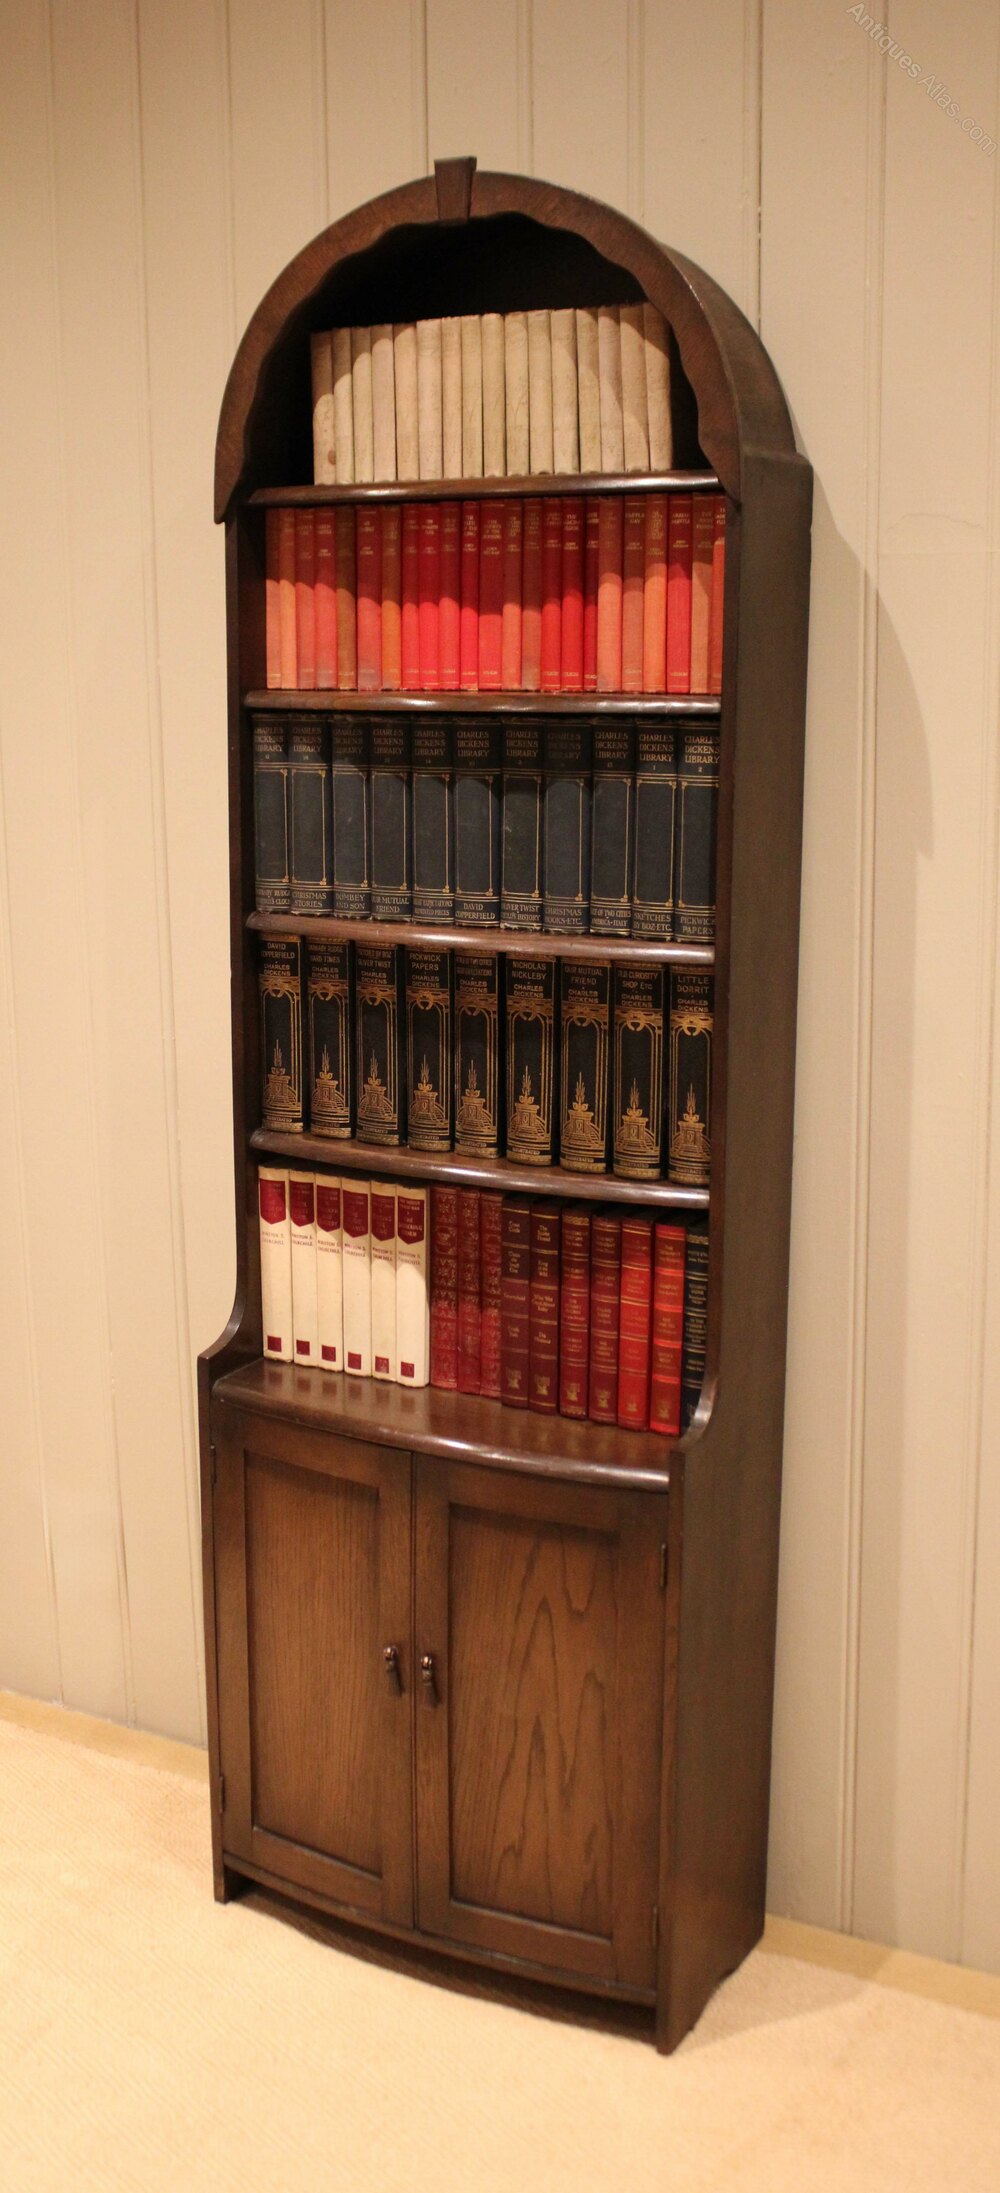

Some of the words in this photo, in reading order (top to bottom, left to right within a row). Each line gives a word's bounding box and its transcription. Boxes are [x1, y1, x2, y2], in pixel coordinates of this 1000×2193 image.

[457, 731, 489, 739] CHARLES
[506, 731, 538, 739] CHARLES
[595, 732, 628, 740] CHARLES
[639, 734, 673, 742] CHARLES
[458, 740, 489, 748] DICKENS
[506, 740, 538, 748] DICKENS
[685, 736, 720, 744] CHARLES
[595, 741, 628, 750] DICKENS
[640, 743, 673, 752] DICKENS
[685, 745, 720, 754] DICKENS
[458, 749, 489, 758] LIBRARY
[506, 749, 537, 758] LIBRARY
[596, 750, 628, 759] LIBRARY
[640, 753, 673, 762] LIBRARY
[685, 754, 720, 764] LIBRARY
[335, 893, 366, 901] DOMBEY
[382, 896, 409, 905] MUTUAL
[349, 902, 365, 910] SON
[376, 905, 400, 913] FRIEND
[463, 902, 483, 910] DAVID
[455, 911, 496, 920] COPPERFIELD
[545, 907, 582, 916] CHRISTMAS
[517, 913, 540, 921] HISTORY
[634, 912, 671, 922] SKETCHES
[683, 926, 713, 935] PAPERS
[410, 953, 440, 961] PICKWICK
[412, 963, 438, 971] PAPERS
[512, 961, 546, 970] NICHOLAS
[512, 971, 547, 980] NICKLEBY
[571, 977, 596, 985] FRIEND
[678, 976, 709, 984] LITTLE
[568, 989, 598, 997] CHARLES
[677, 985, 709, 993] DORRIT
[621, 1000, 653, 1008] DICKENS
[678, 998, 708, 1006] CHARLES
